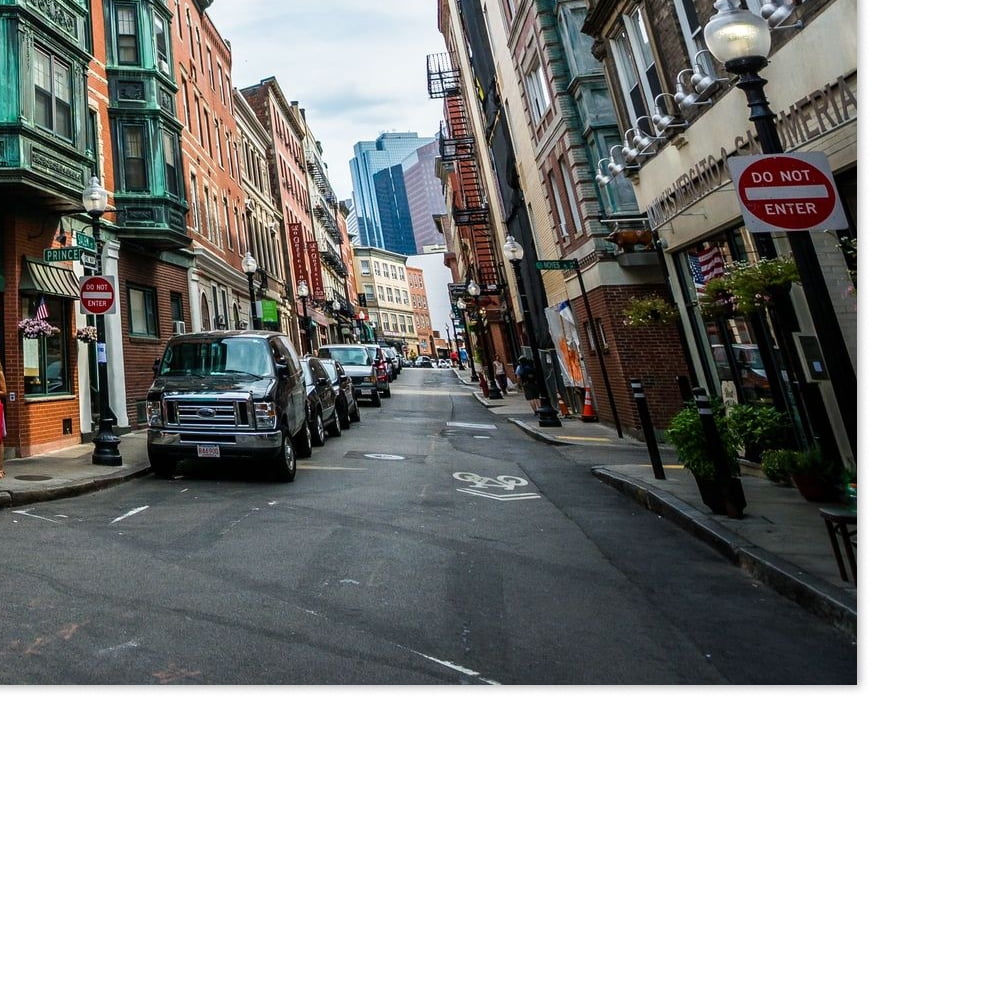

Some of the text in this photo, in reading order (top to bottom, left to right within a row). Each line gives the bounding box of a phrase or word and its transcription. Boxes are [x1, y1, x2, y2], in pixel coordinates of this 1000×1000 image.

[751, 169, 811, 183] DO NOT
[764, 202, 818, 215] ENTER
[47, 250, 78, 261] PRINCE
